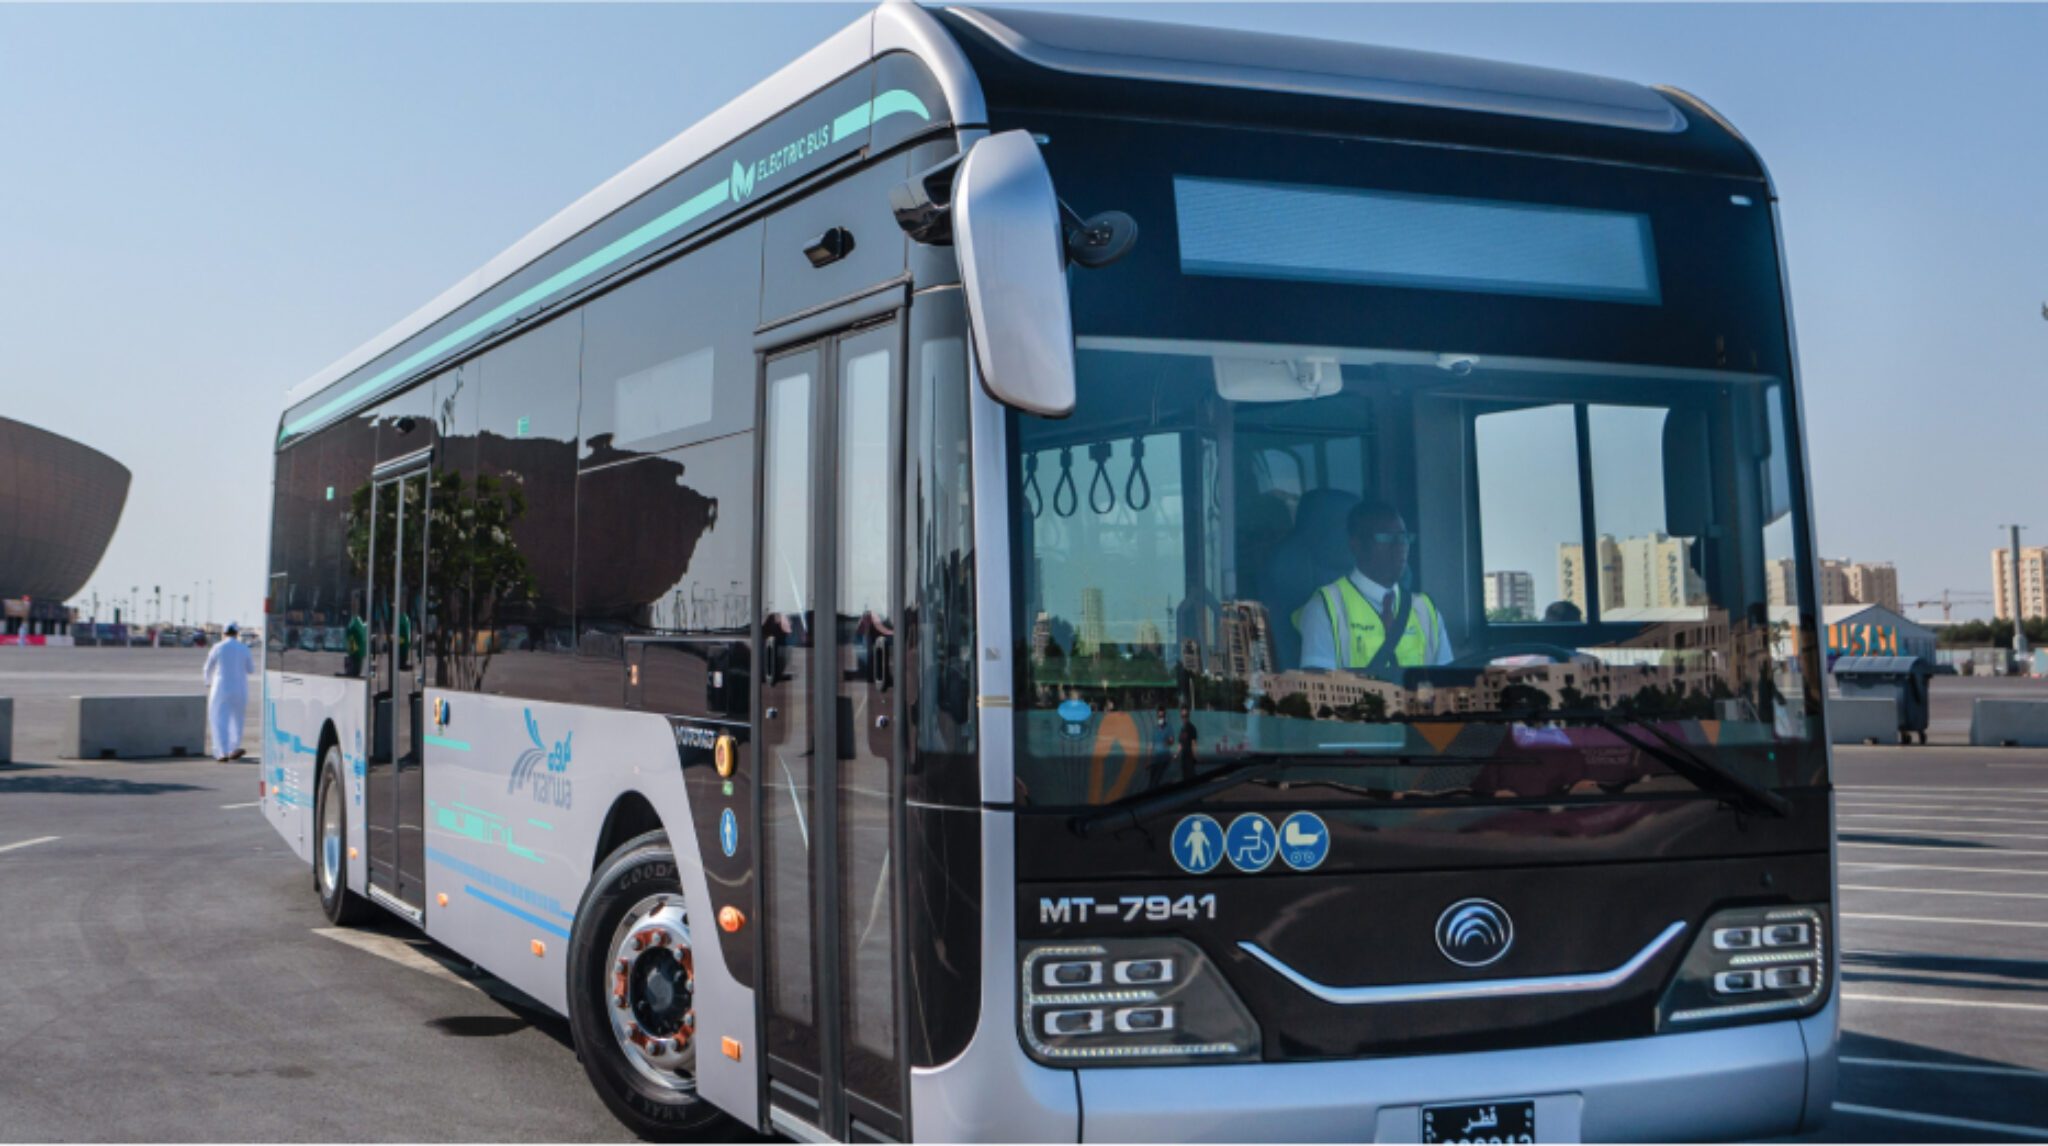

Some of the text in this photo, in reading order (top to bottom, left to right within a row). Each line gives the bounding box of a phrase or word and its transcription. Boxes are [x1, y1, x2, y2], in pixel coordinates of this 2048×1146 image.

[759, 124, 829, 180] ELECTRIC BUS
[1039, 892, 1217, 923] MT-7941
[1461, 1105, 1499, 1134] قطر
